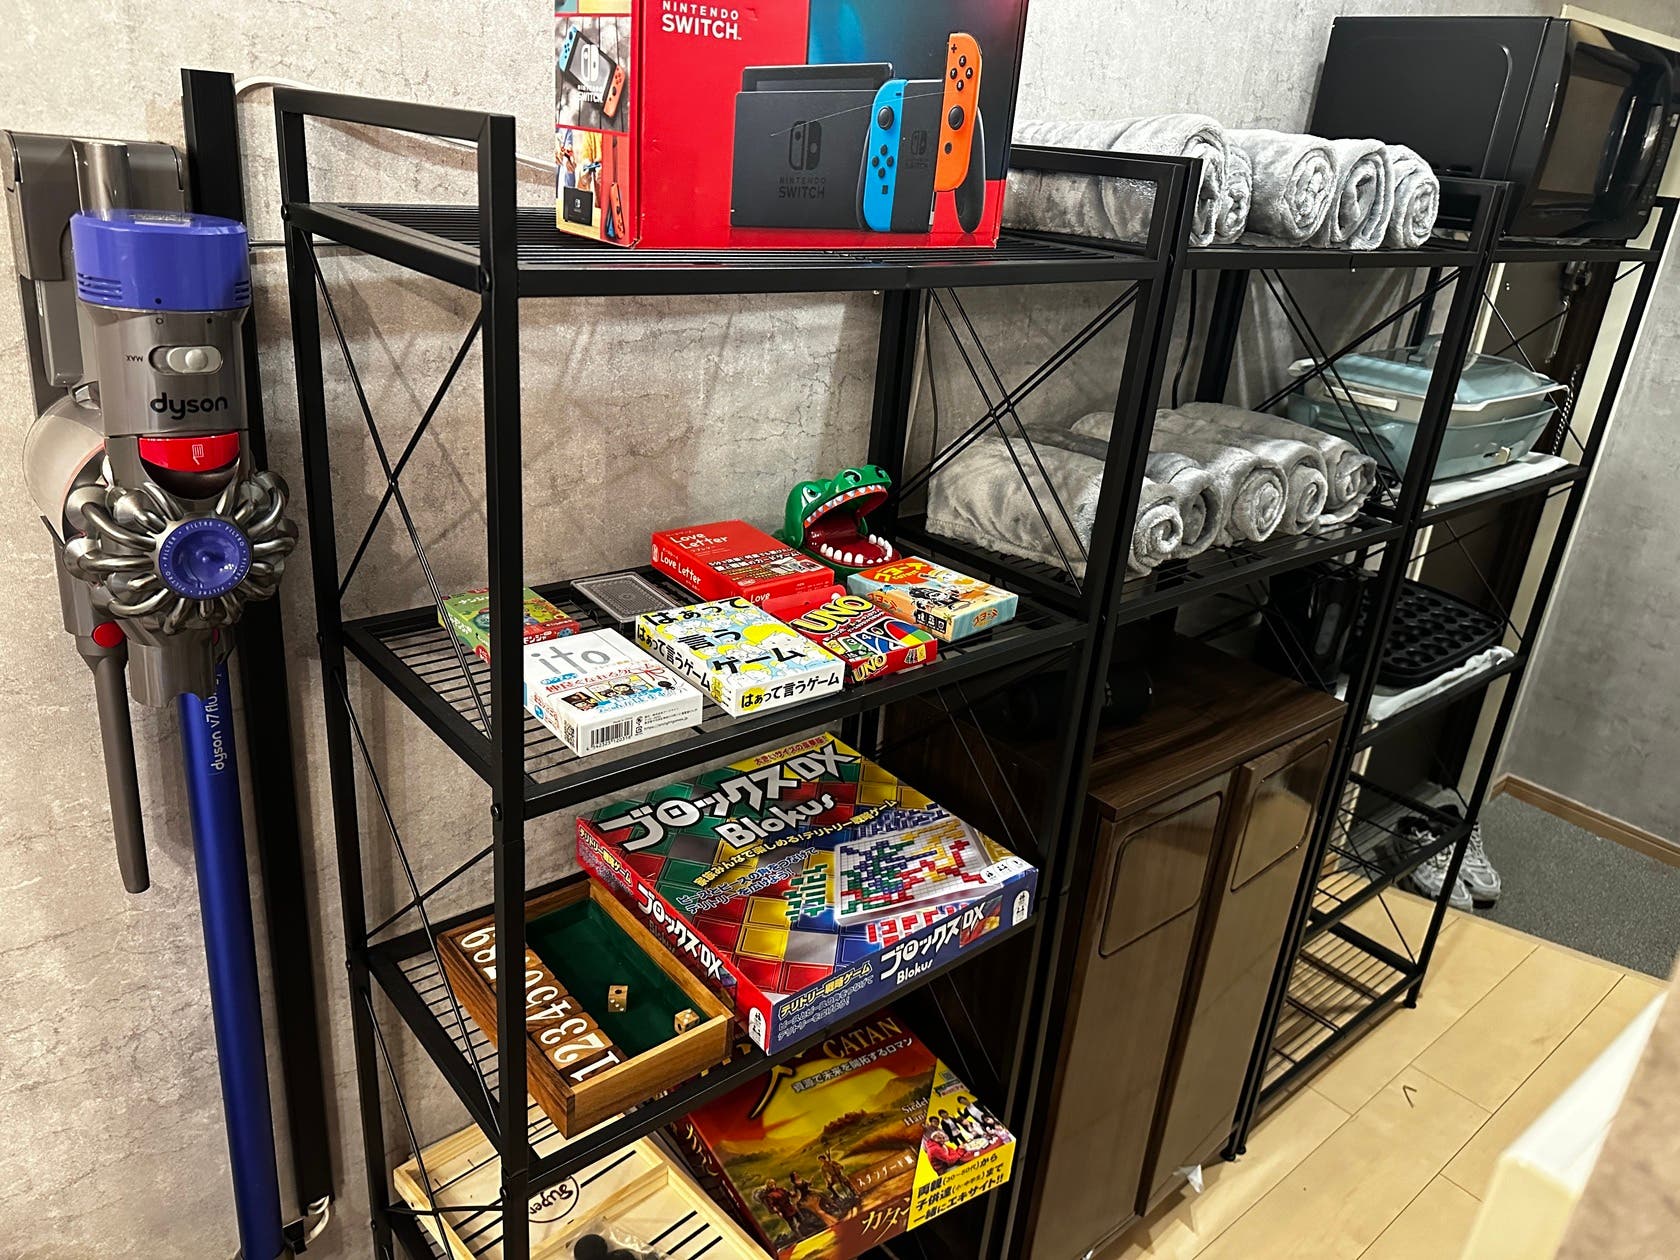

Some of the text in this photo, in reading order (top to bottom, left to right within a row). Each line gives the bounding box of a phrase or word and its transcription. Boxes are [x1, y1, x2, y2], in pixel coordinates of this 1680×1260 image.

[662, 0, 739, 20] NINTENDO
[661, 13, 738, 40] SWITCH
[778, 185, 825, 198] SWITCH
[150, 392, 228, 420] dyson
[670, 533, 706, 543] Love
[680, 536, 728, 549] Letter
[660, 552, 677, 569] Love
[678, 563, 702, 585] Letter
[643, 597, 750, 626] はぁって
[751, 592, 771, 604] Love
[791, 596, 874, 633] UNO
[678, 628, 741, 651] 言う
[531, 646, 611, 675] ito
[637, 624, 711, 691] はぁって言うゲーム
[713, 647, 806, 674] ゲーム
[852, 654, 887, 682] UNO
[741, 672, 840, 708] はぁって言うゲーム
[210, 731, 227, 771] dyson
[598, 743, 856, 851] ブロックスDX
[715, 793, 835, 848] Blokus
[637, 883, 723, 980] ブロックスDX
[880, 902, 985, 980] ブロックスDX
[896, 959, 934, 985] Blokus
[525, 999, 572, 1021] 4
[540, 1017, 588, 1045] 3
[823, 1017, 902, 1059] CATAN
[553, 1032, 605, 1063] 2
[569, 1050, 621, 1082] 1
[901, 1097, 930, 1114] Siedel
